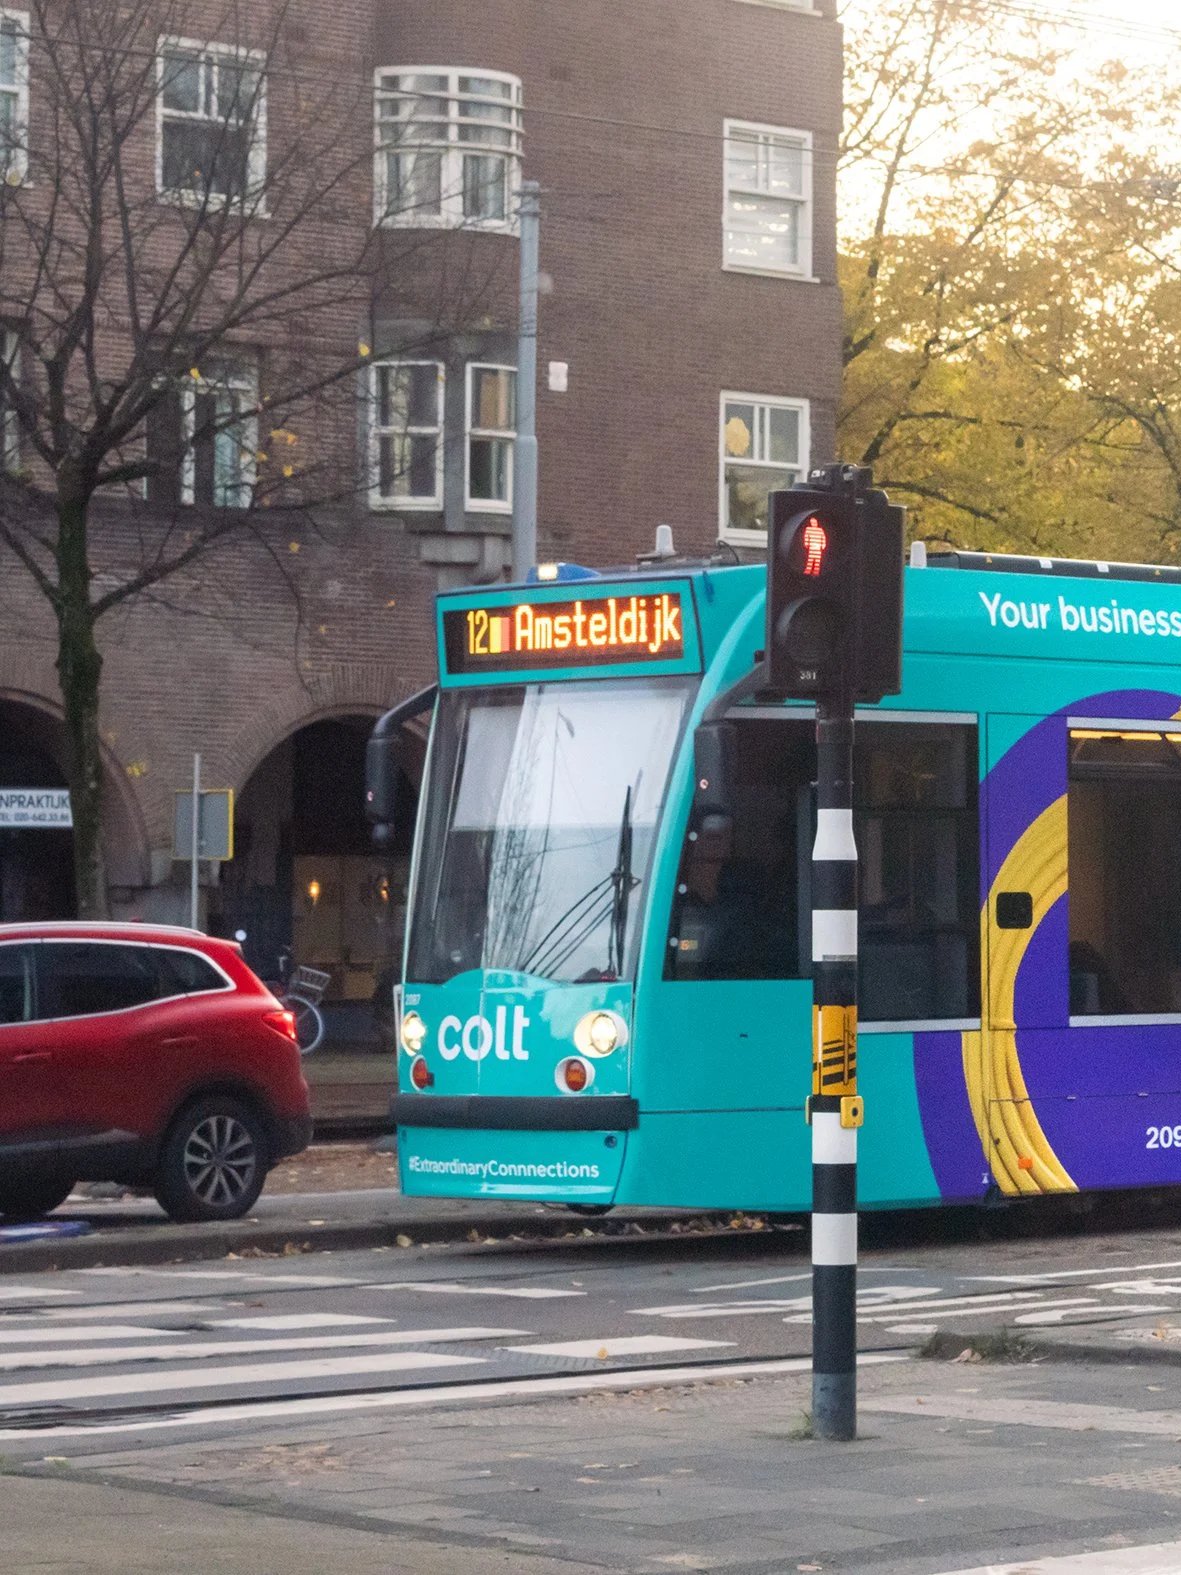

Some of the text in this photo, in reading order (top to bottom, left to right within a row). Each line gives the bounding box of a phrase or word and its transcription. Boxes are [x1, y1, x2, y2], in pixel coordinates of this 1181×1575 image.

[466, 595, 681, 654] 12 Amsteldijk
[978, 592, 1050, 630] Your
[438, 1005, 530, 1061] colt
